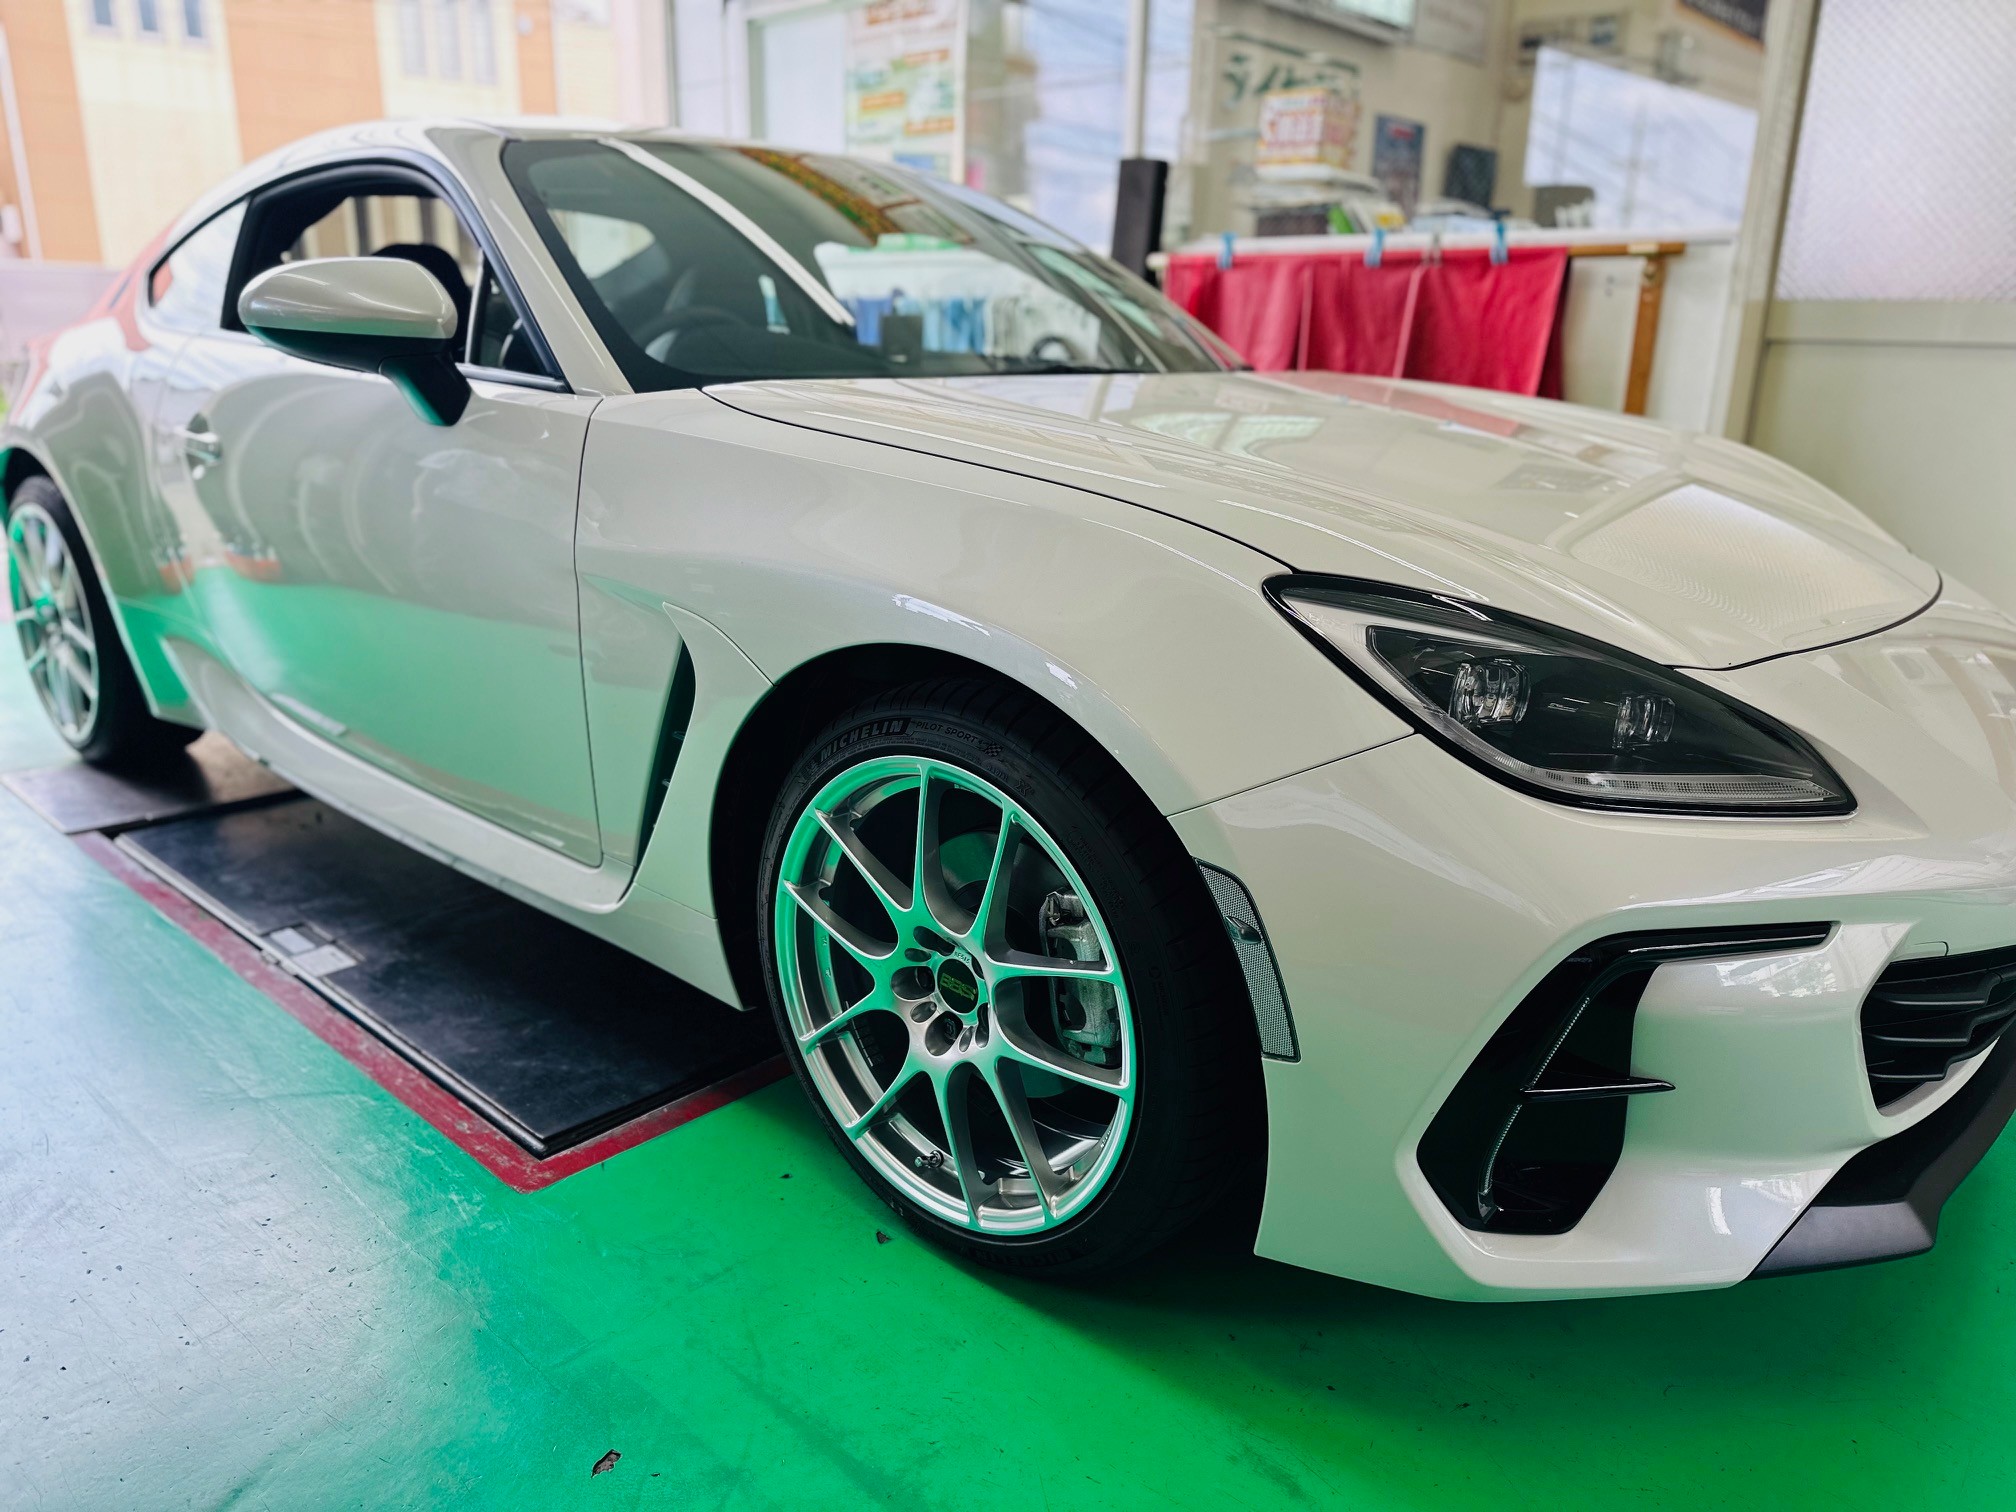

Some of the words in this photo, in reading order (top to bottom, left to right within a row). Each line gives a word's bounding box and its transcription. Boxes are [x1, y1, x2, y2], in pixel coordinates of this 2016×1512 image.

[819, 719, 905, 763] MICHELIN
[915, 721, 944, 732] PILOT
[944, 726, 979, 743] SPORT
[940, 972, 976, 1001] BBS
